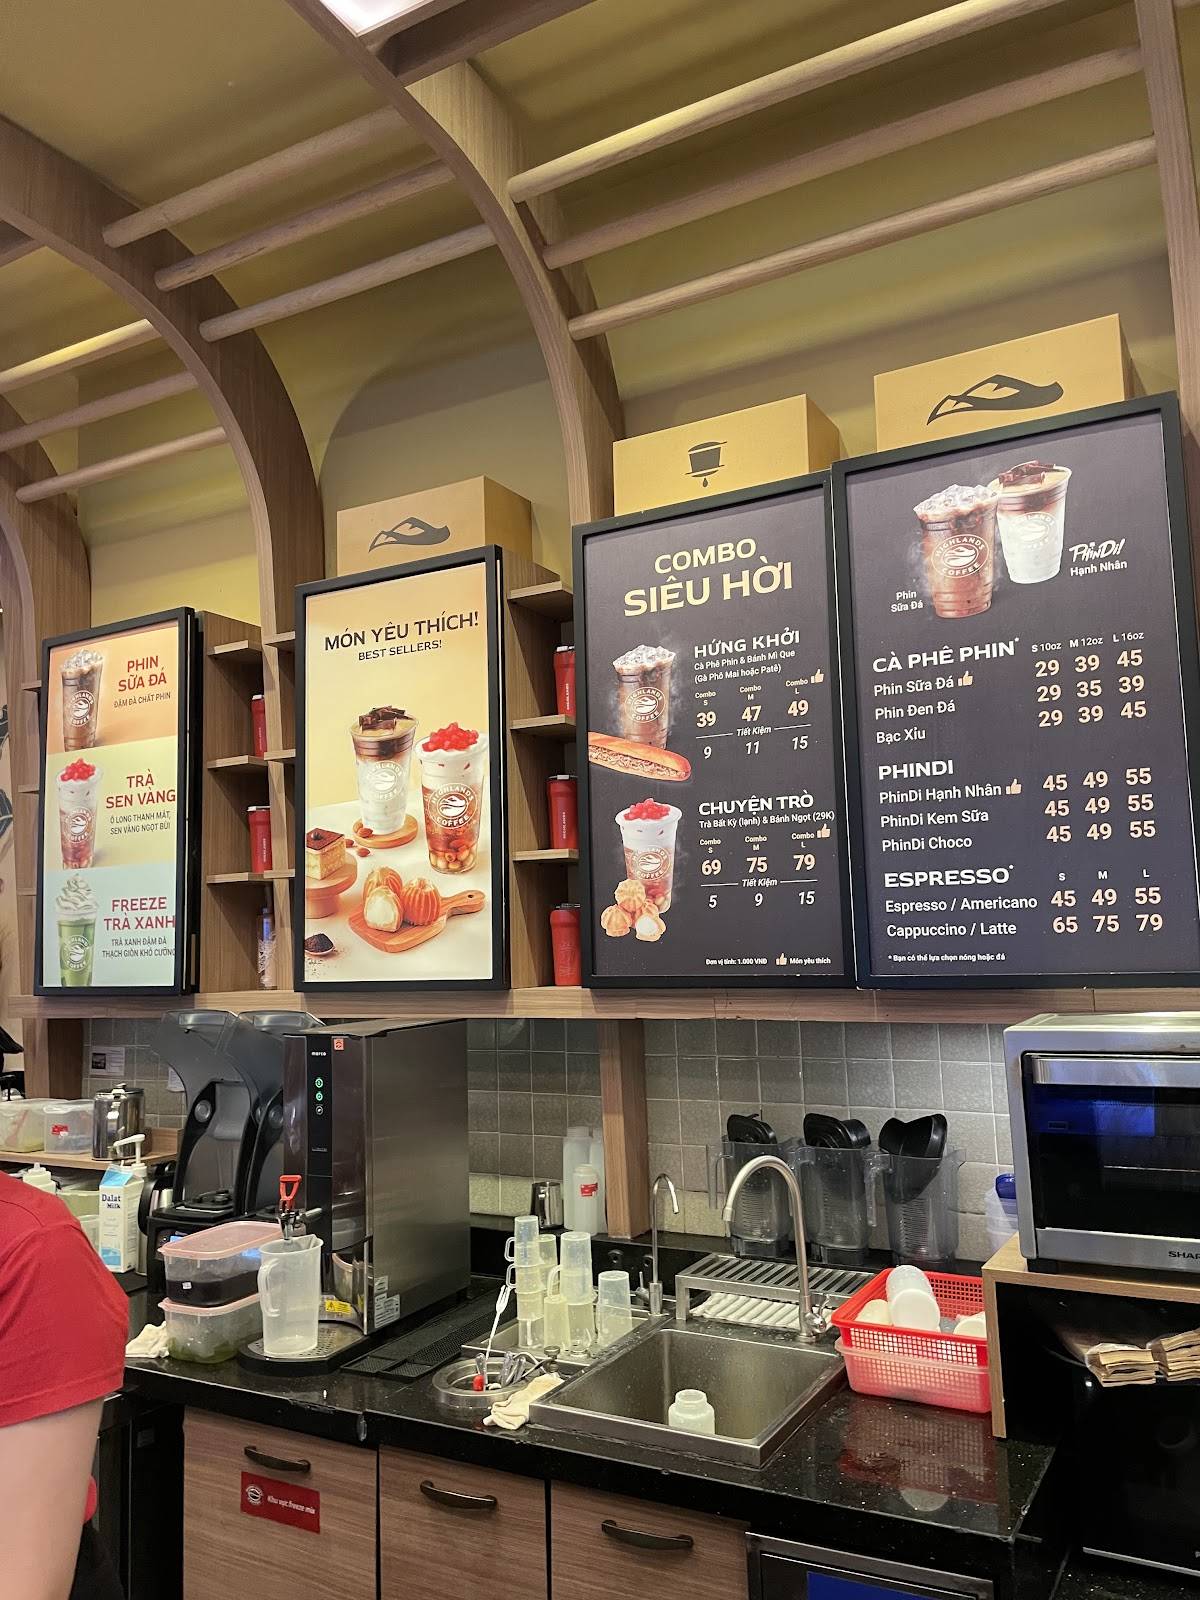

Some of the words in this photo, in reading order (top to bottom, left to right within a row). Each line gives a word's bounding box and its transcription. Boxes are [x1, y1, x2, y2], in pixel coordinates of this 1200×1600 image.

[654, 538, 757, 574] COMBO
[935, 536, 986, 557] HIGHLANDS
[942, 562, 981, 576] COFFEE
[1070, 563, 1098, 577] Hạnh
[1100, 560, 1128, 572] Nhân
[624, 576, 711, 617] SIÊU
[722, 555, 793, 601] HỜI
[895, 590, 917, 600] Phin
[890, 602, 909, 613] Sữa
[909, 599, 924, 610] Đá
[324, 627, 366, 651] MÓN
[371, 621, 409, 643] YÊU
[414, 610, 479, 636] THÍCH!
[358, 648, 387, 661] BEST
[389, 639, 442, 656] SELLERS!
[694, 639, 747, 659] HỨNG
[752, 627, 800, 650] KHỞI
[1031, 644, 1038, 653] S
[1040, 642, 1062, 652] 10oz
[1069, 639, 1079, 648] M
[1080, 637, 1104, 647] 12oz
[1112, 635, 1119, 643] L
[1121, 631, 1144, 641] 16oz
[127, 655, 159, 673] PHIN
[706, 659, 720, 669] Phê
[722, 657, 738, 667] Phin
[740, 656, 746, 665] &
[747, 653, 767, 664] Bánh
[779, 649, 796, 660] Que
[872, 651, 903, 673] CÀ
[908, 645, 954, 669] PHÊ
[1034, 659, 1060, 678] 29
[1074, 654, 1100, 673] 39
[1116, 648, 1143, 667] 45
[118, 673, 145, 692] SỮA
[148, 666, 167, 686] ĐÁ
[725, 669, 740, 679] Mai
[741, 667, 760, 678] hoặc
[785, 678, 809, 687] Combo
[695, 690, 717, 699] Combo
[740, 684, 762, 693] Combo
[795, 687, 800, 695] L
[874, 683, 903, 697] Phin
[906, 679, 933, 693] Sữa
[935, 675, 954, 690] Đá
[1036, 684, 1062, 702] 29
[1076, 679, 1102, 698] 35
[1118, 675, 1145, 693] 39
[696, 711, 717, 728] 39
[741, 705, 763, 722] 47
[787, 699, 809, 717] 49
[875, 706, 904, 720] Phin
[907, 704, 934, 717] Đen
[937, 699, 956, 714] Đá
[1038, 709, 1063, 728] 29
[1078, 705, 1104, 723] 39
[1120, 700, 1147, 719] 45
[736, 727, 751, 737] Tiết
[876, 731, 901, 745] Bạc
[904, 726, 926, 741] Xỉu
[703, 745, 712, 759] 9
[745, 740, 760, 755] 11
[791, 735, 809, 750] 15
[126, 768, 155, 789] TRÀ
[878, 759, 954, 780] PHINDI
[1042, 774, 1068, 791] 45
[1082, 770, 1109, 788] 49
[1125, 767, 1152, 785] 55
[105, 794, 133, 809] SEN
[137, 786, 176, 805] VÀNG
[698, 795, 773, 816] CHUYỆN
[775, 789, 814, 811] TRÒ
[879, 789, 922, 804] PhinDi
[925, 785, 961, 802] Hạnh
[965, 783, 1002, 798] Nhân
[1044, 799, 1070, 817] 45
[1084, 796, 1111, 814] 49
[1127, 793, 1154, 812] 55
[115, 814, 132, 824] LONG
[133, 811, 155, 822] THANH
[700, 819, 712, 829] Trà
[738, 816, 761, 828] (lạnh)
[762, 816, 769, 825] &
[769, 814, 790, 825] Bánh
[791, 812, 811, 824] Ngọt
[812, 810, 835, 822] (29K)
[880, 812, 924, 828] PhinDi
[927, 812, 958, 825] Kem
[961, 809, 990, 823] Sữa
[110, 827, 122, 836] SEN
[123, 824, 140, 835] VÀNG
[744, 835, 768, 843] Combo
[791, 831, 815, 840] Combo
[1046, 825, 1072, 842] 45
[1086, 822, 1112, 840] 49
[1129, 820, 1156, 838] 55
[699, 838, 721, 846] Combo
[881, 837, 925, 852] PhinDi
[928, 836, 973, 850] Choco
[701, 859, 722, 876] 69
[746, 856, 768, 874] 75
[793, 853, 816, 871] 79
[741, 879, 757, 888] Tiết
[1058, 872, 1066, 881] S
[1098, 870, 1108, 880] M
[1142, 868, 1150, 878] L
[111, 896, 168, 912] FREEZE
[708, 894, 718, 909] 5
[754, 892, 764, 907] 9
[798, 890, 816, 905] 15
[885, 899, 948, 915] Espresso
[950, 898, 957, 911] /
[960, 896, 1038, 910] Americano
[1050, 890, 1077, 907] 45
[1091, 888, 1117, 906] 49
[1134, 886, 1162, 905] 55
[103, 912, 131, 931] TRÀ
[134, 915, 176, 930] XANH
[886, 923, 967, 939] Cappuccino
[970, 922, 977, 936] /
[980, 922, 1017, 936] Latte
[1052, 916, 1079, 933] 65
[1092, 914, 1120, 933] 75
[1135, 913, 1163, 932] 79
[124, 938, 141, 946] XANH
[101, 1193, 121, 1202] Dalat
